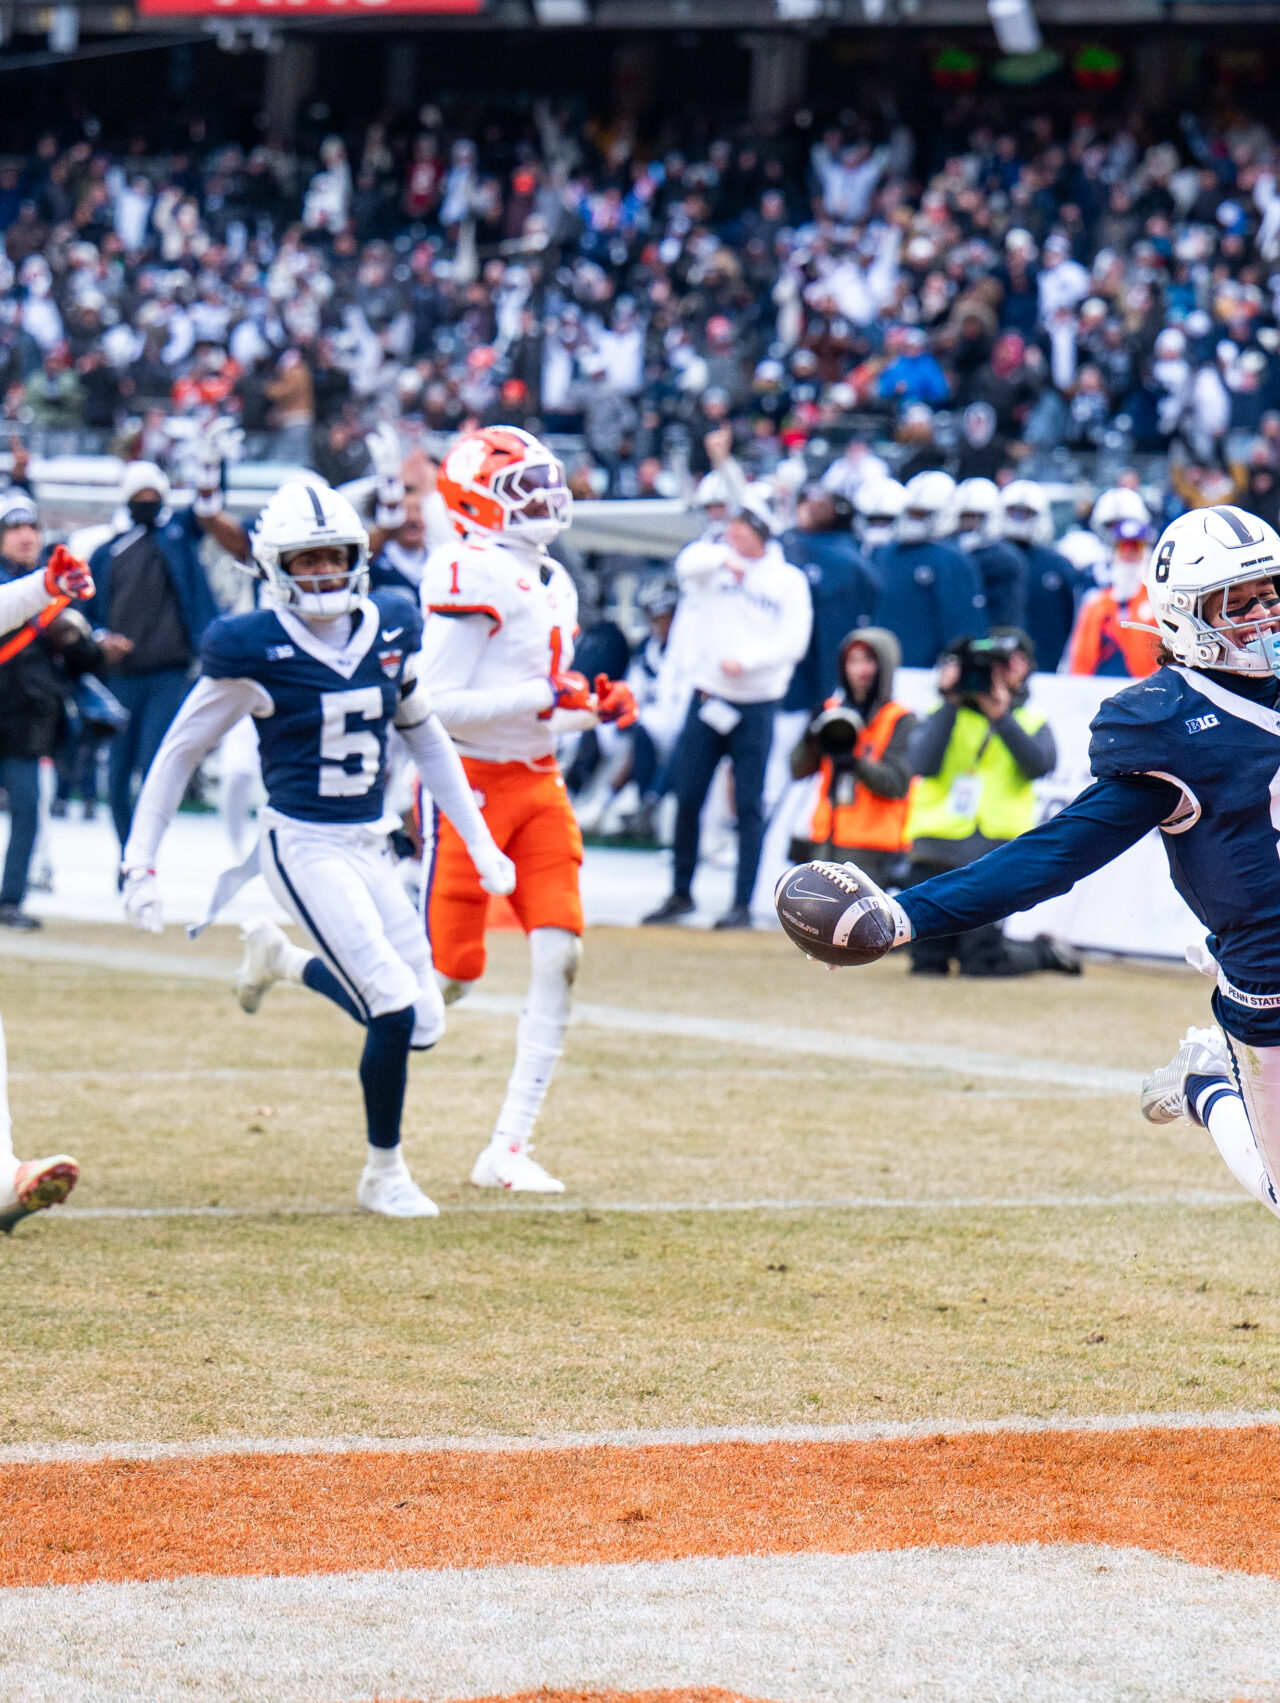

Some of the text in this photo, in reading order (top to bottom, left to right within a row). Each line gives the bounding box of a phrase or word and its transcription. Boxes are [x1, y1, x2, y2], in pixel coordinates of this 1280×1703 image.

[449, 561, 461, 595] 1
[1155, 540, 1176, 584] 8
[318, 685, 384, 797] 5
[1228, 987, 1249, 1004] PENN
